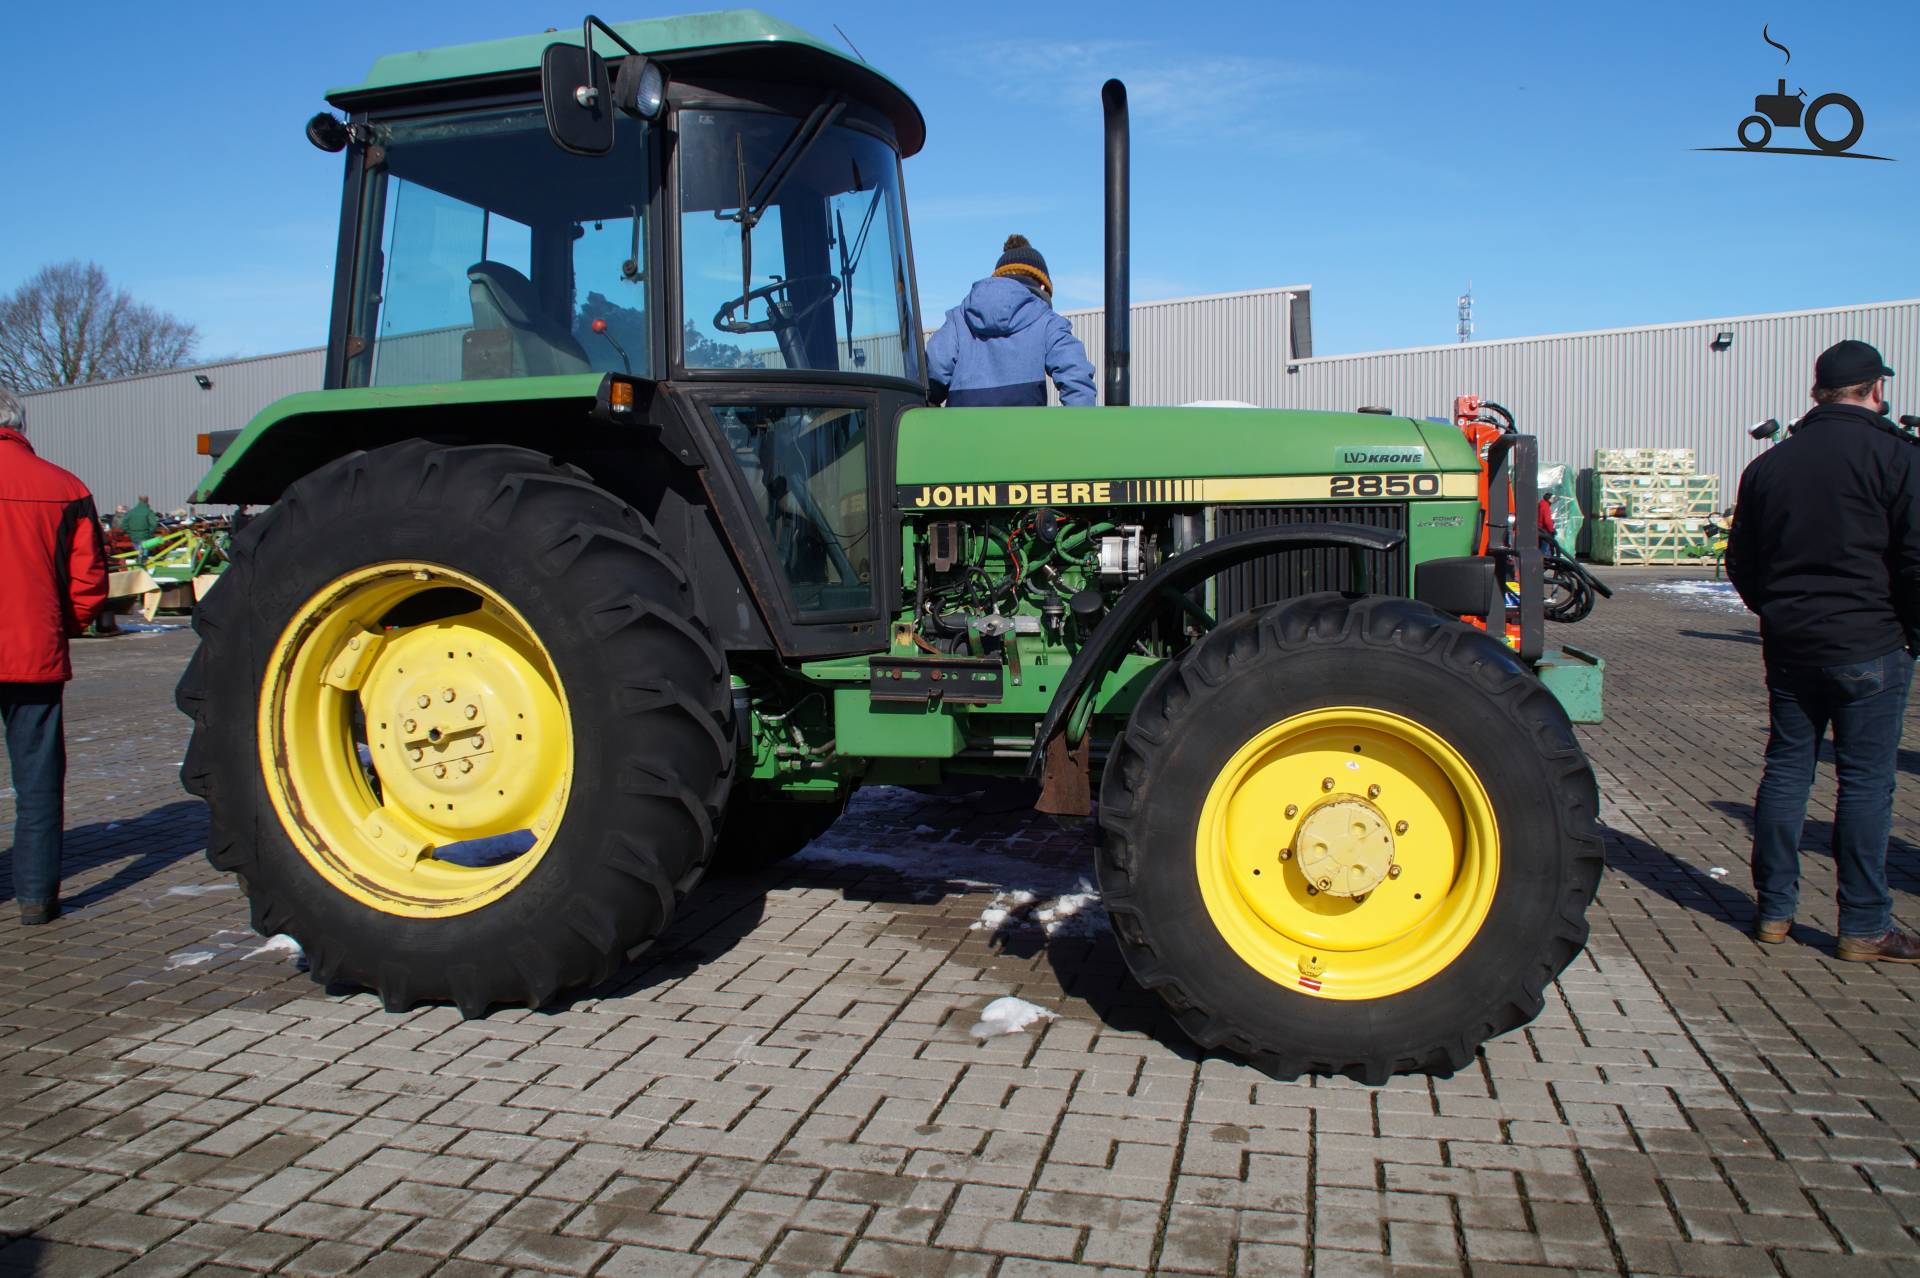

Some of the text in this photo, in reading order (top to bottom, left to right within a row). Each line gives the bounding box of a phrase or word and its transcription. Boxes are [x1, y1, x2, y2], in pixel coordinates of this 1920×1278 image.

[1368, 453, 1422, 464] KRONE
[915, 482, 1111, 507] JOHN DEERE
[1330, 474, 1440, 498] 2850
